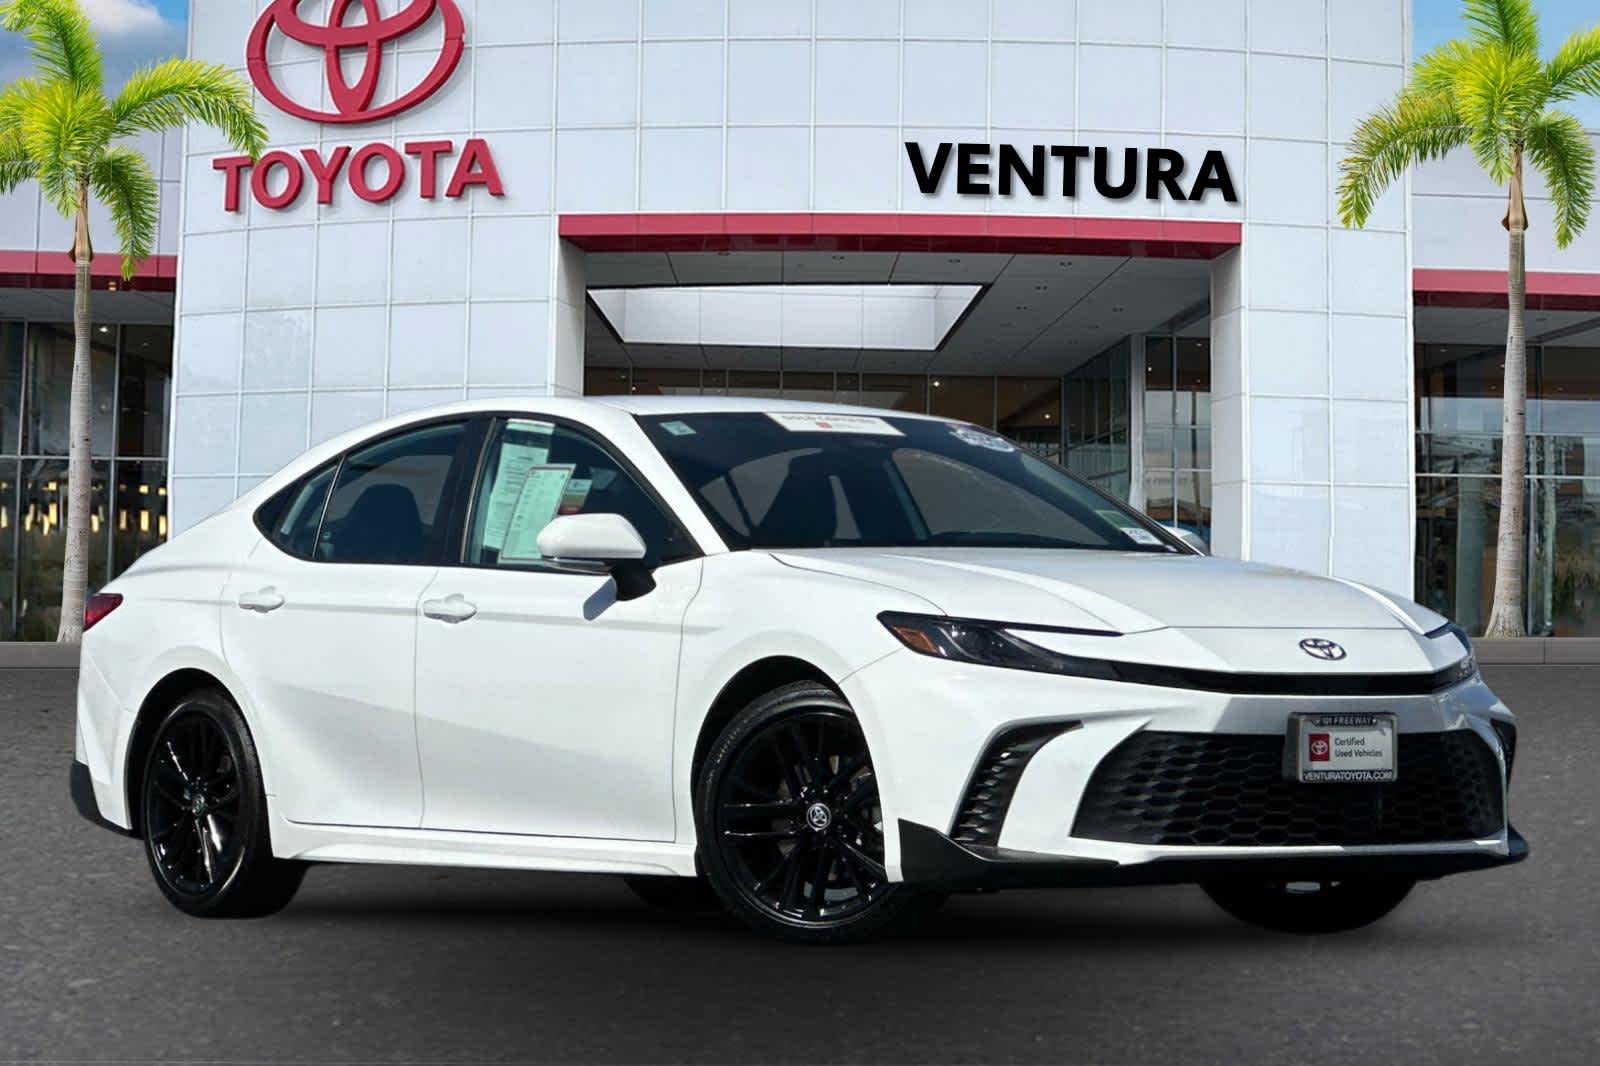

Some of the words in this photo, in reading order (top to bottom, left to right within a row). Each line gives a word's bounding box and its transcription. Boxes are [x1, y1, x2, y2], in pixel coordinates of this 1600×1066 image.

[212, 138, 505, 212] TOYOTA
[904, 142, 1239, 202] VENTURA
[1334, 736, 1365, 746] Certified
[1335, 749, 1353, 758] Used
[1354, 749, 1383, 758] Vehicles
[1304, 771, 1393, 781] VENTURATOYOTA.COM
